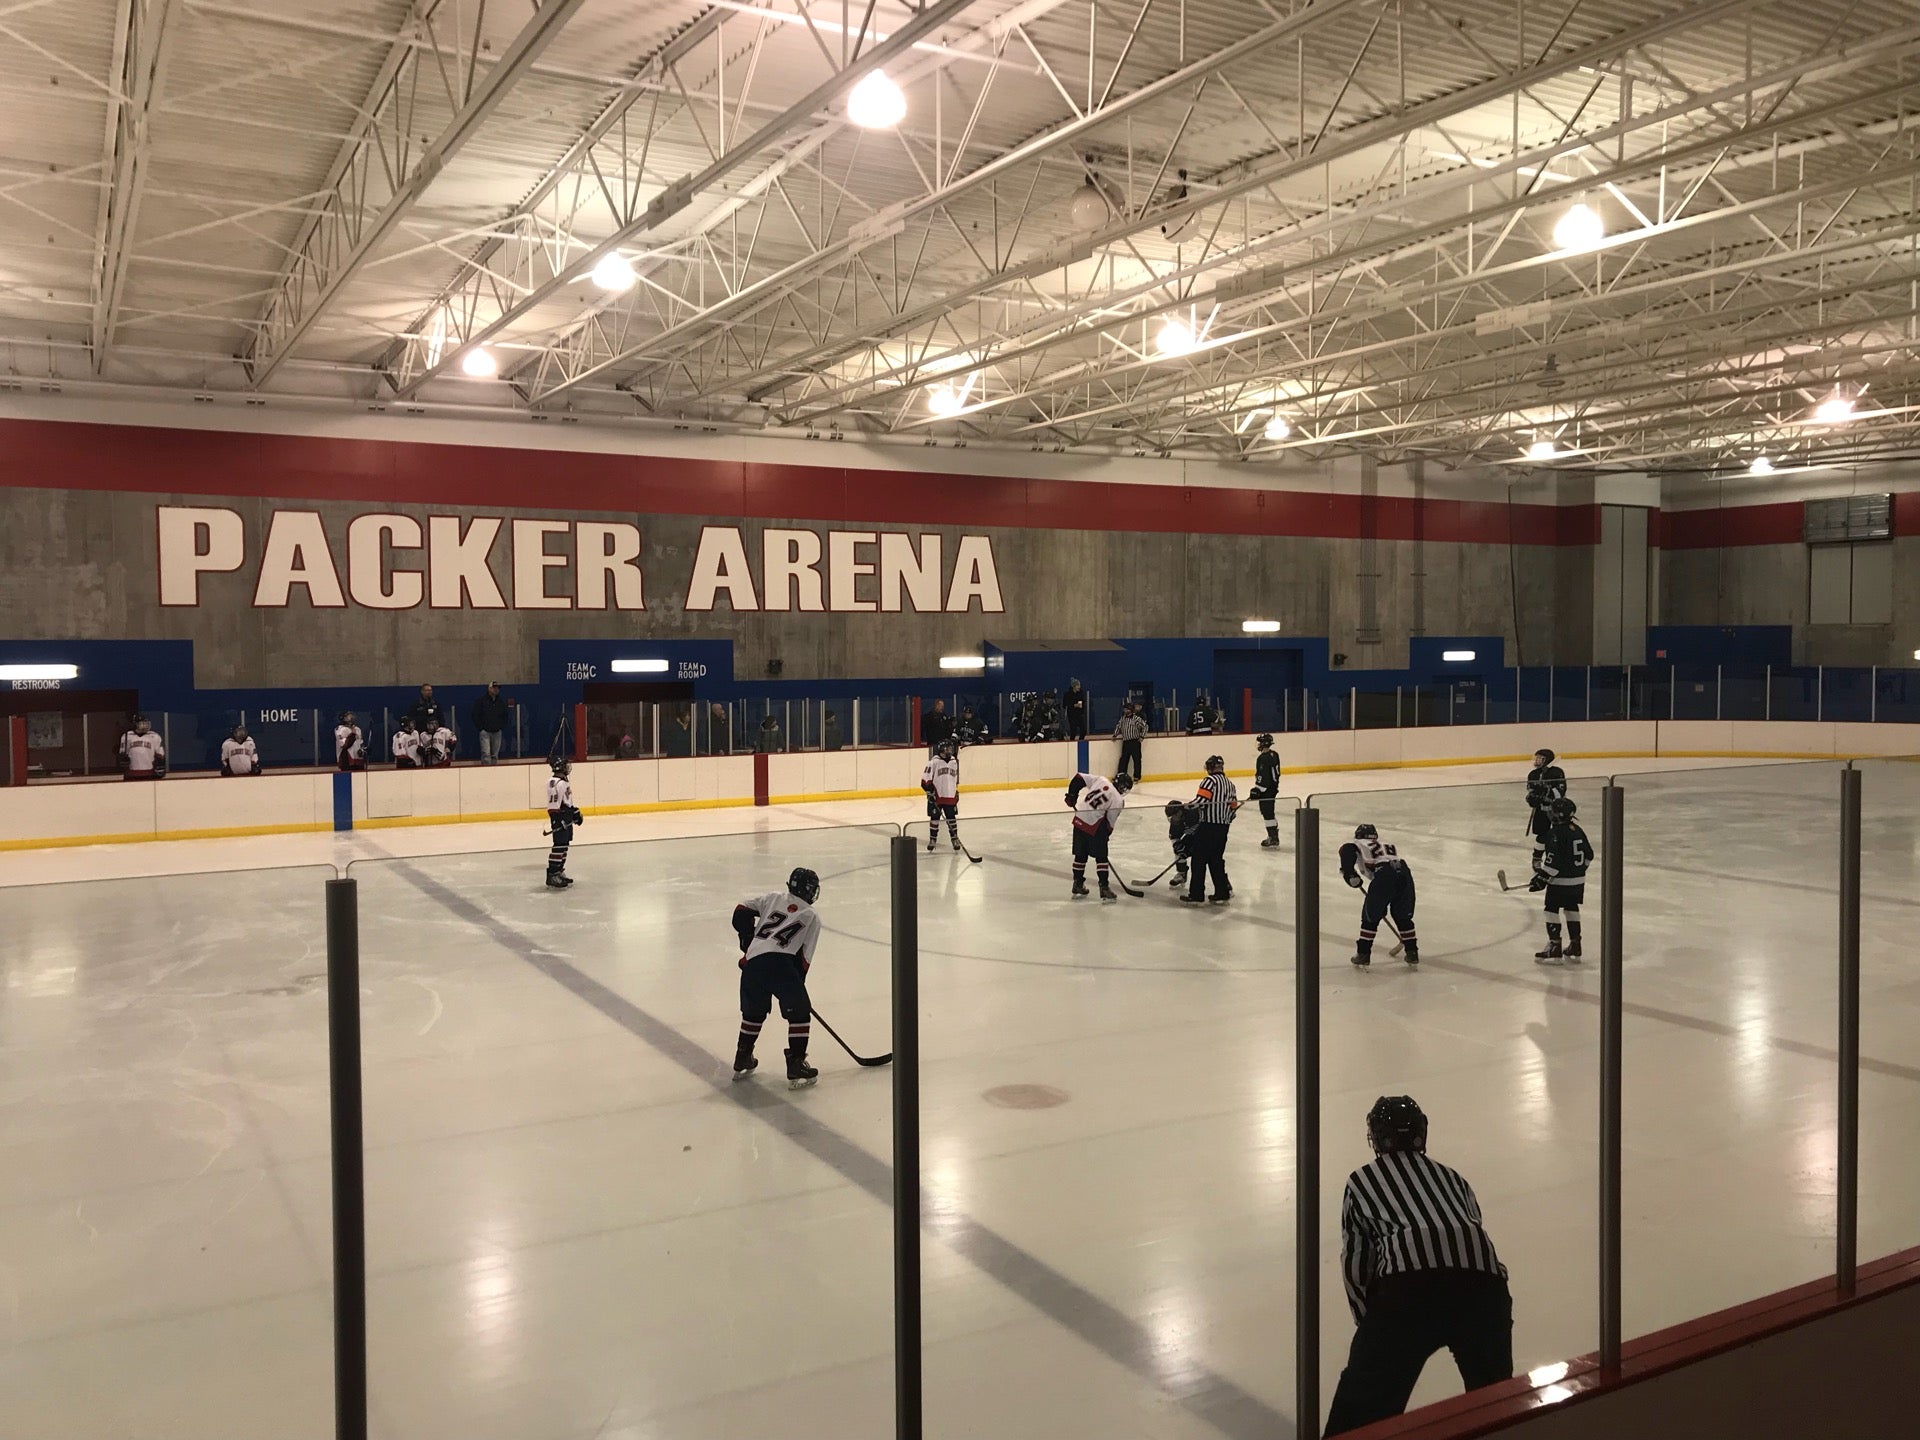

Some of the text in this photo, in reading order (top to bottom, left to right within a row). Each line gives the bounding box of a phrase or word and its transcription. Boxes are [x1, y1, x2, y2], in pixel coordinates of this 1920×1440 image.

[156, 505, 1006, 614] PACKER ARENA
[566, 665, 597, 680] ROOM C
[567, 662, 589, 672] TEAM
[678, 662, 699, 671] TEAM
[678, 664, 707, 679] ROOM D
[12, 679, 61, 690] RESTROOMS
[260, 708, 299, 722] HOME
[1545, 851, 1555, 864] 5
[1572, 839, 1585, 867] 5
[755, 910, 806, 950] 24
